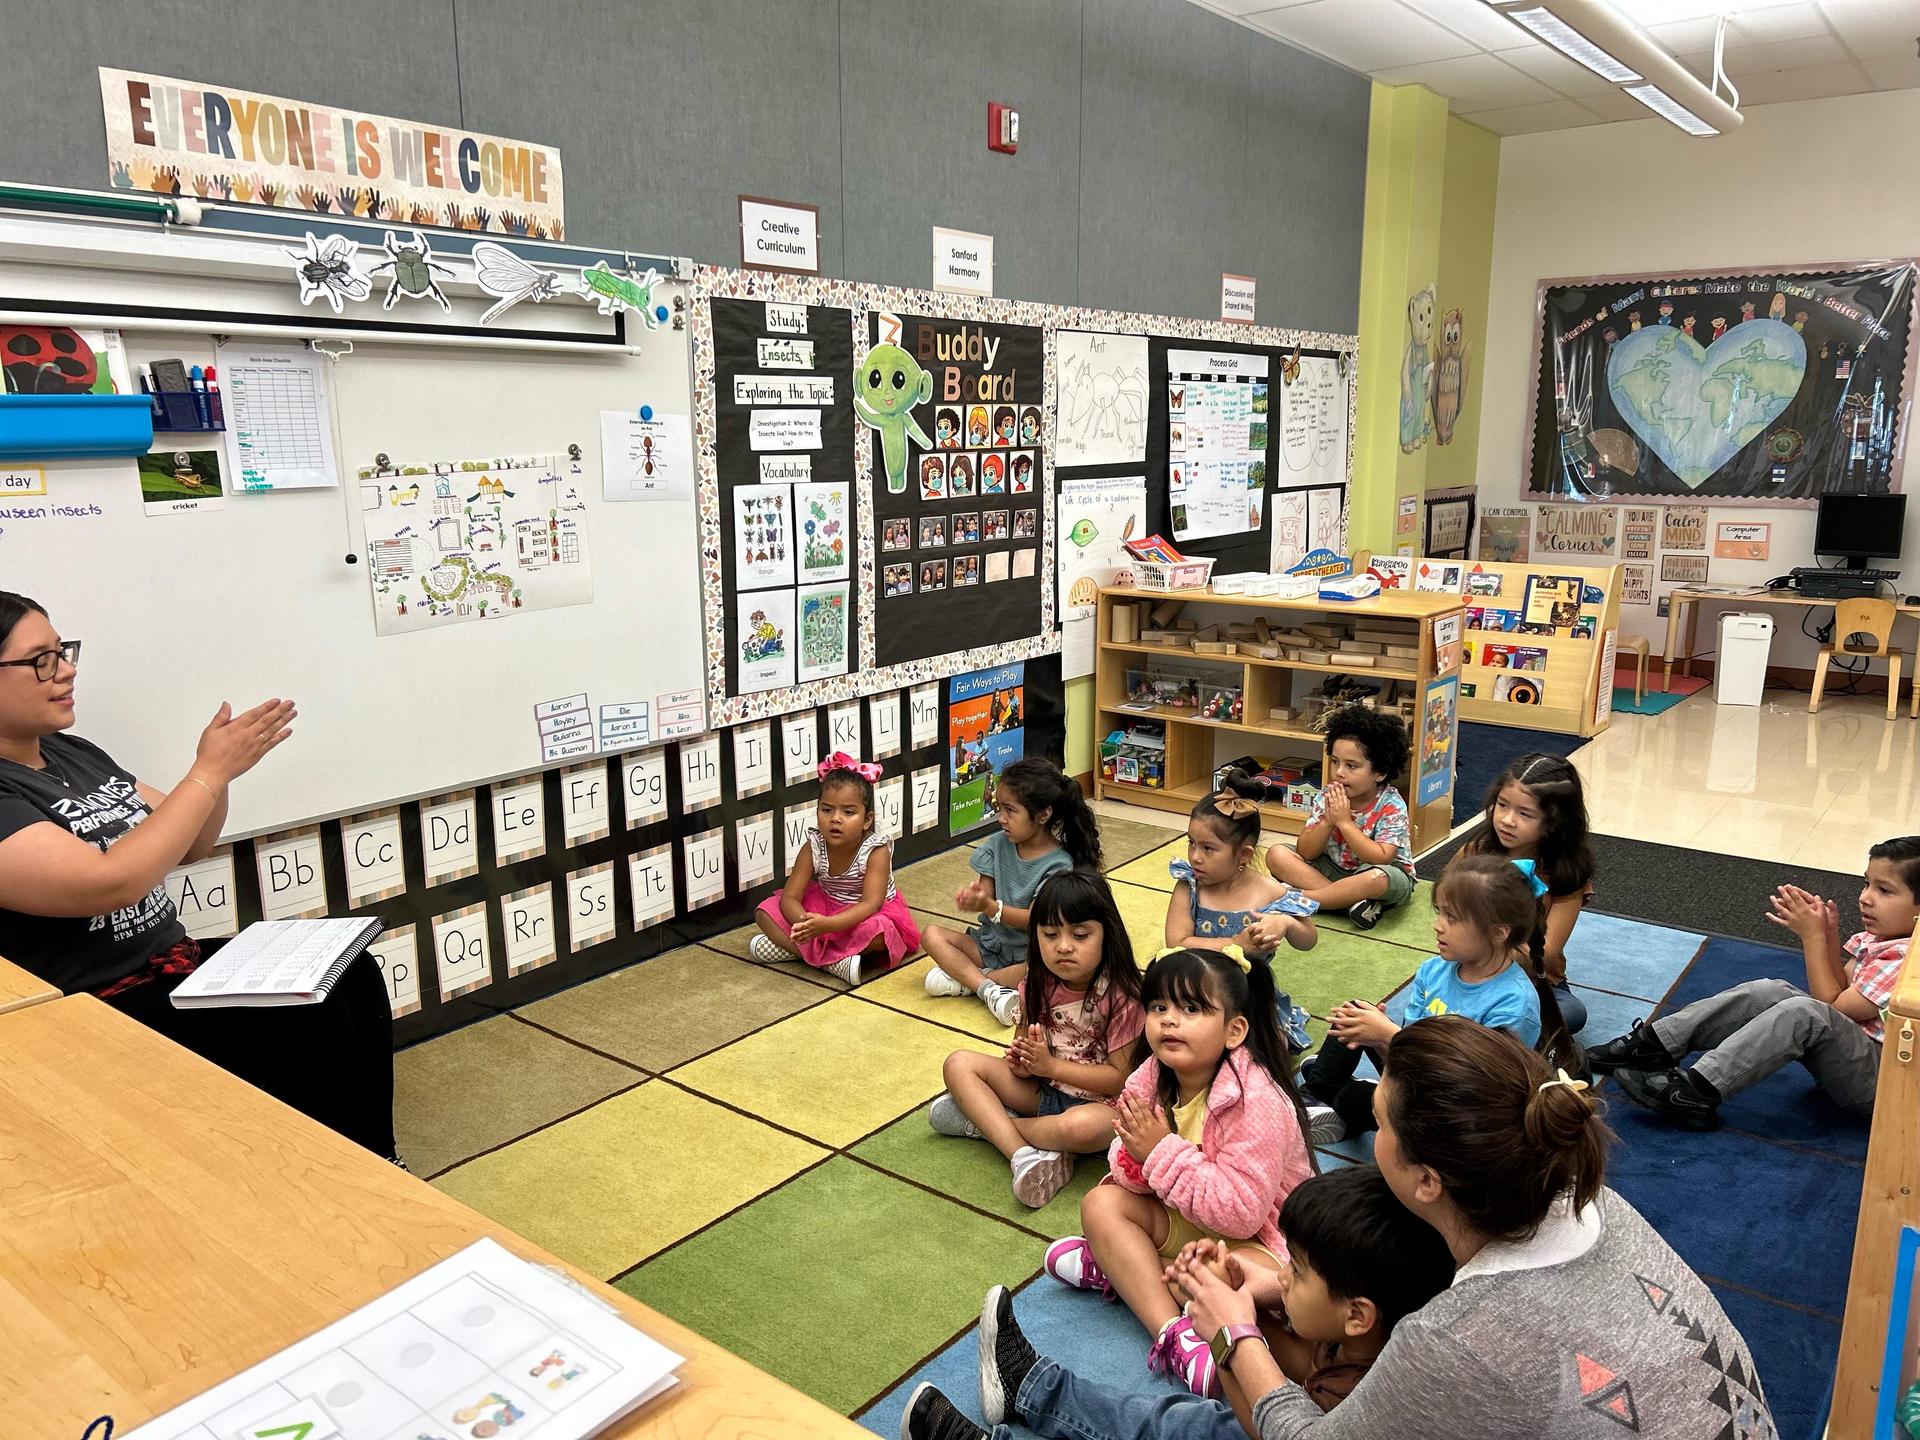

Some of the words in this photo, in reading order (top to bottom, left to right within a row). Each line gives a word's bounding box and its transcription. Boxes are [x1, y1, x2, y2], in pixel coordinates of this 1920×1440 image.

[127, 80, 336, 173] EVERYONE
[342, 117, 381, 180] IS
[389, 126, 548, 204] WELCOME
[761, 220, 800, 235] Creative
[757, 239, 806, 255] Curriculum
[951, 248, 977, 262] Sanford
[949, 265, 980, 280] Harmony
[1224, 288, 1246, 299] Discussion
[1224, 301, 1240, 310] Shared
[1555, 317, 1595, 346] Friends
[1595, 307, 1608, 322] of
[1611, 288, 1645, 314] Many
[1650, 285, 1702, 298] Cultures
[1704, 282, 1741, 295] Make
[1747, 280, 1769, 293] the
[1776, 279, 1815, 300] World
[1823, 296, 1862, 321] Better
[770, 310, 805, 333] Study:
[917, 324, 1001, 371] Buddy
[1090, 336, 1107, 353] Ant
[1209, 358, 1228, 368] Process
[1228, 359, 1239, 369] Grid
[943, 367, 1016, 402] Board
[736, 382, 782, 404] Exploring
[789, 384, 804, 399] the
[807, 384, 835, 406] Topic:
[757, 420, 786, 428] Investigation
[762, 463, 809, 479] Vocabulary
[5, 475, 31, 488] day
[51, 504, 102, 517] insects
[172, 502, 198, 510] cricket
[1488, 508, 1500, 516] CAN
[1503, 508, 1528, 517] CONTROL
[1546, 511, 1607, 535] CALMING
[1628, 511, 1640, 522] YOU
[1641, 512, 1653, 523] ARE
[1665, 513, 1704, 528] Calm
[1551, 535, 1598, 552] Corner
[1665, 528, 1700, 542] MIND
[1318, 563, 1345, 577] THEATER
[1372, 558, 1408, 569] Kangaroo
[1666, 558, 1679, 567] YOUR
[1625, 567, 1644, 578] THINK
[1665, 568, 1703, 579] Matter
[1624, 579, 1643, 589] HAPPY
[1440, 619, 1454, 632] Library
[956, 681, 970, 694] Fair
[972, 676, 992, 691] Ways
[993, 674, 1001, 685] to
[1002, 671, 1018, 684] Play
[551, 701, 572, 712] Aaron
[912, 700, 937, 726] Mm
[553, 715, 576, 728] Hayley
[879, 709, 894, 734] Ll
[952, 716, 965, 727] Play
[965, 710, 988, 724] together
[611, 723, 631, 732] Aaron
[835, 716, 856, 745] Kk
[561, 744, 588, 755] Guzman
[745, 740, 762, 769] Ii
[791, 728, 812, 766] Jj
[997, 746, 1012, 756] Trade
[687, 749, 715, 782] Hh
[630, 766, 662, 805] Gg
[1427, 780, 1443, 794] Library
[50, 776, 135, 818] RAMONES
[571, 781, 600, 814] Ff
[918, 782, 936, 808] Zz
[503, 796, 535, 831] Ee
[879, 794, 899, 826] Yy
[952, 801, 965, 812] Take
[965, 798, 981, 808] turns
[431, 809, 470, 850] Dd
[355, 832, 393, 867] Cc
[744, 831, 768, 860] Vv
[269, 850, 314, 892] Bb
[691, 848, 719, 879] Uu
[640, 867, 666, 897] Tt
[179, 875, 226, 916] Aa
[579, 886, 606, 917] Ss
[89, 915, 106, 932] 23
[111, 903, 141, 925] EAST
[514, 910, 545, 942] Rr
[113, 929, 134, 942] 8PM
[444, 930, 484, 969] Qq
